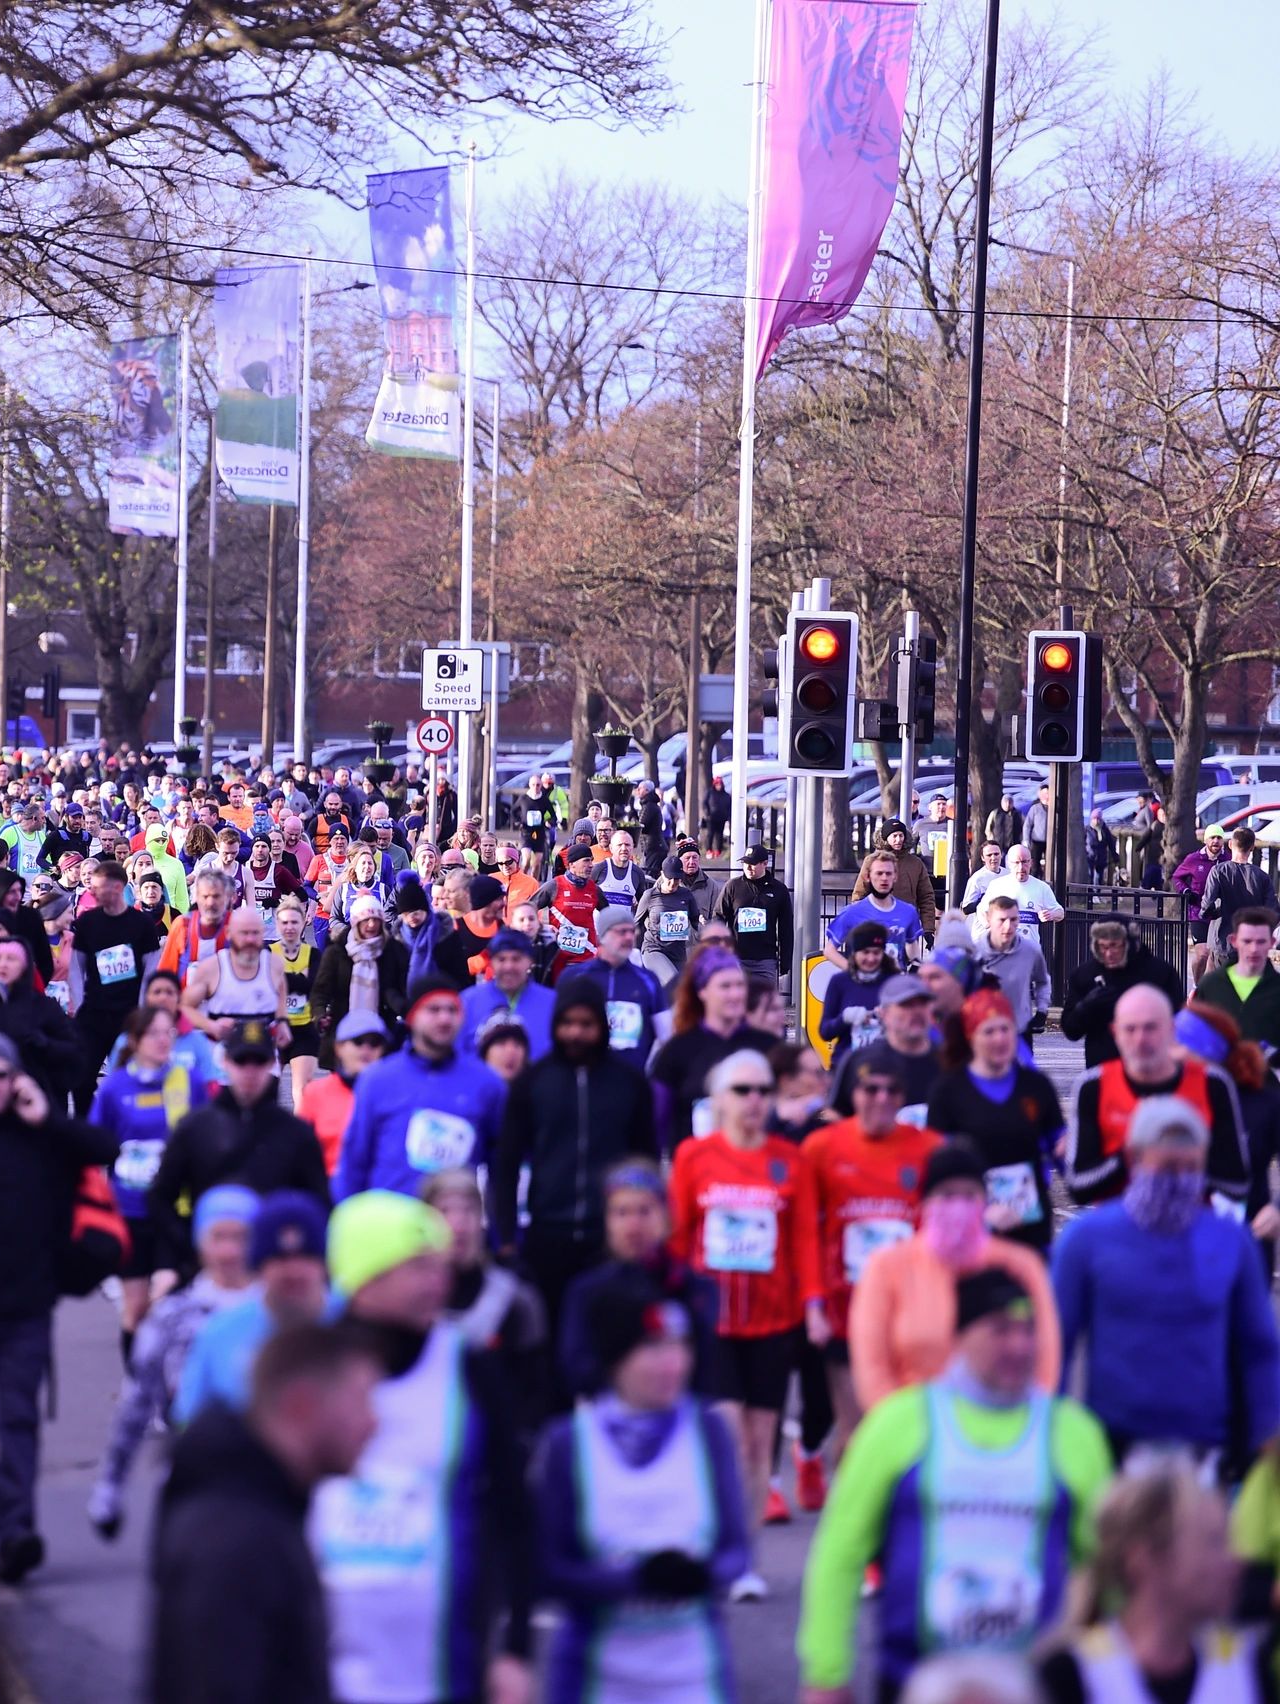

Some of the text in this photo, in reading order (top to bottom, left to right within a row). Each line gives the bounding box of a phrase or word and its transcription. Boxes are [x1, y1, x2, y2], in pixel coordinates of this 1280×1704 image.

[434, 683, 471, 694] Speed
[427, 697, 477, 706] cameras
[422, 728, 449, 743] 40
[666, 923, 684, 933] 1202
[744, 918, 761, 928] 1204
[562, 936, 581, 949] 2331
[104, 961, 130, 977] 2126
